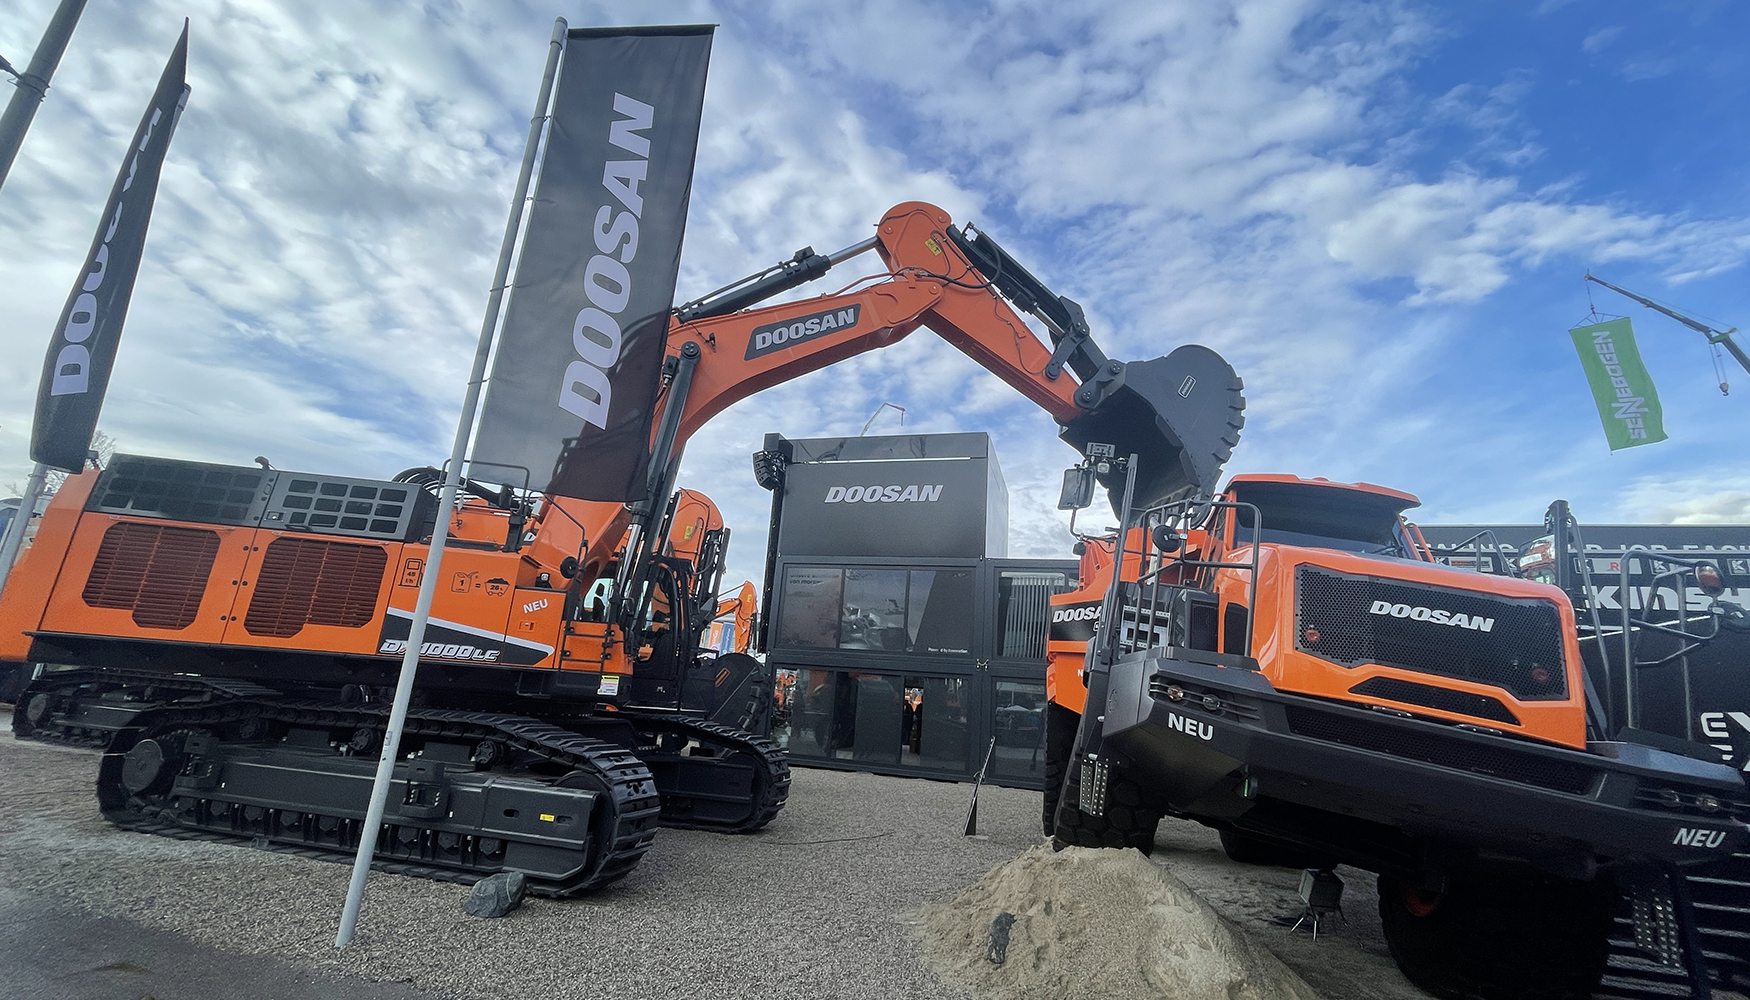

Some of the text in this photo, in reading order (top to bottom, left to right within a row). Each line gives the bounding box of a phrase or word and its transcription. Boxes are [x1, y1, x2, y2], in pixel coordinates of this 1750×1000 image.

[558, 92, 655, 431] DOOSAN
[755, 308, 855, 351] DOOSAN
[824, 484, 944, 503] DOOSAN
[523, 598, 549, 614] NEU
[1052, 605, 1102, 623] DOOSA
[1369, 600, 1495, 632] DOOSAN
[1168, 712, 1214, 741] NEU
[1672, 828, 1726, 849] NEU
